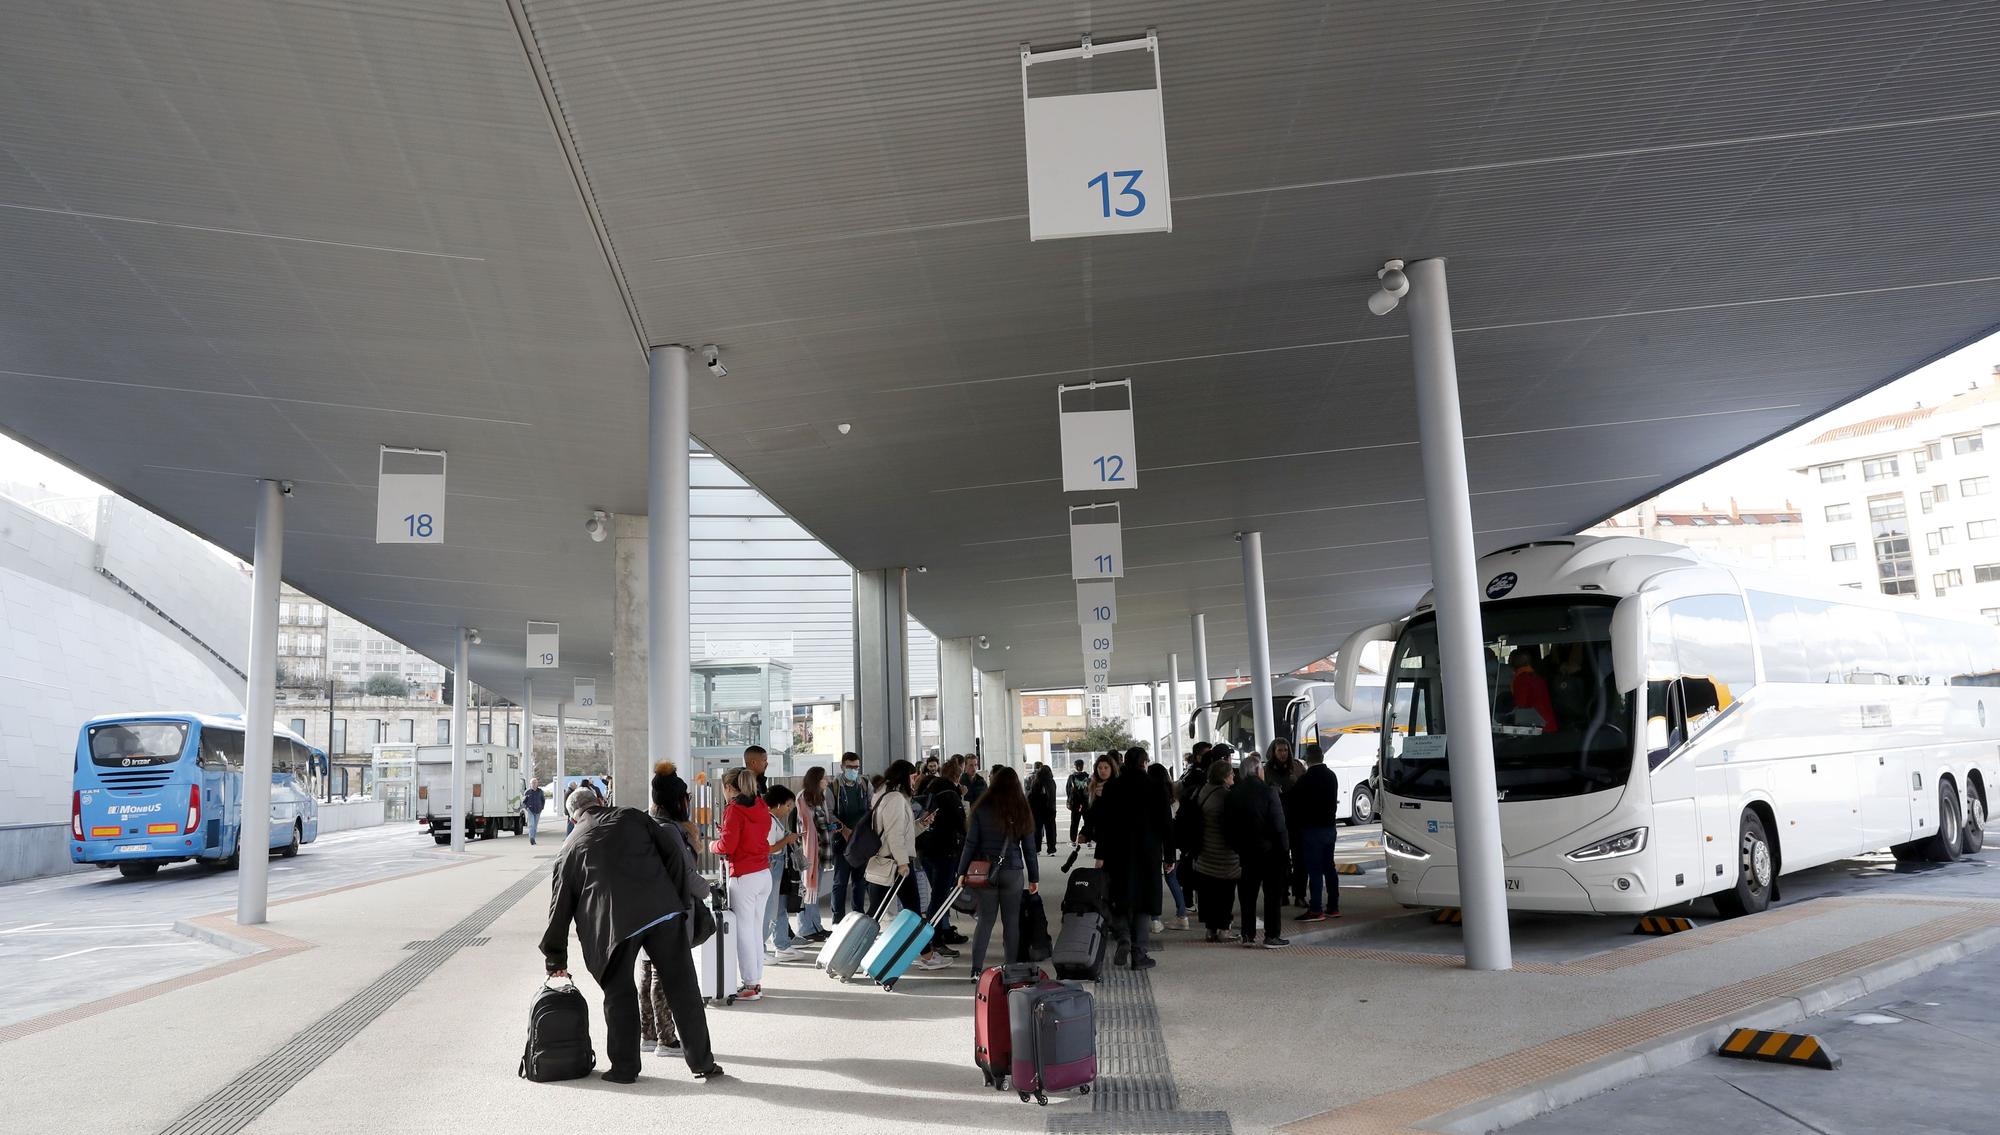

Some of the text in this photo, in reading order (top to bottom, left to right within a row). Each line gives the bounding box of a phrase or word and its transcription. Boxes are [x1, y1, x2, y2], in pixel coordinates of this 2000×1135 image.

[1088, 169, 1146, 218] 13
[1093, 455, 1125, 482] 12
[404, 513, 433, 537] 18
[1094, 554, 1113, 573] 11
[1093, 606, 1111, 621] 10
[1093, 638, 1110, 650] 09
[539, 653, 554, 665] 19
[1093, 659, 1108, 670] 08
[1093, 674, 1106, 683] 07
[1095, 684, 1106, 693] 06
[582, 698, 593, 706] 20
